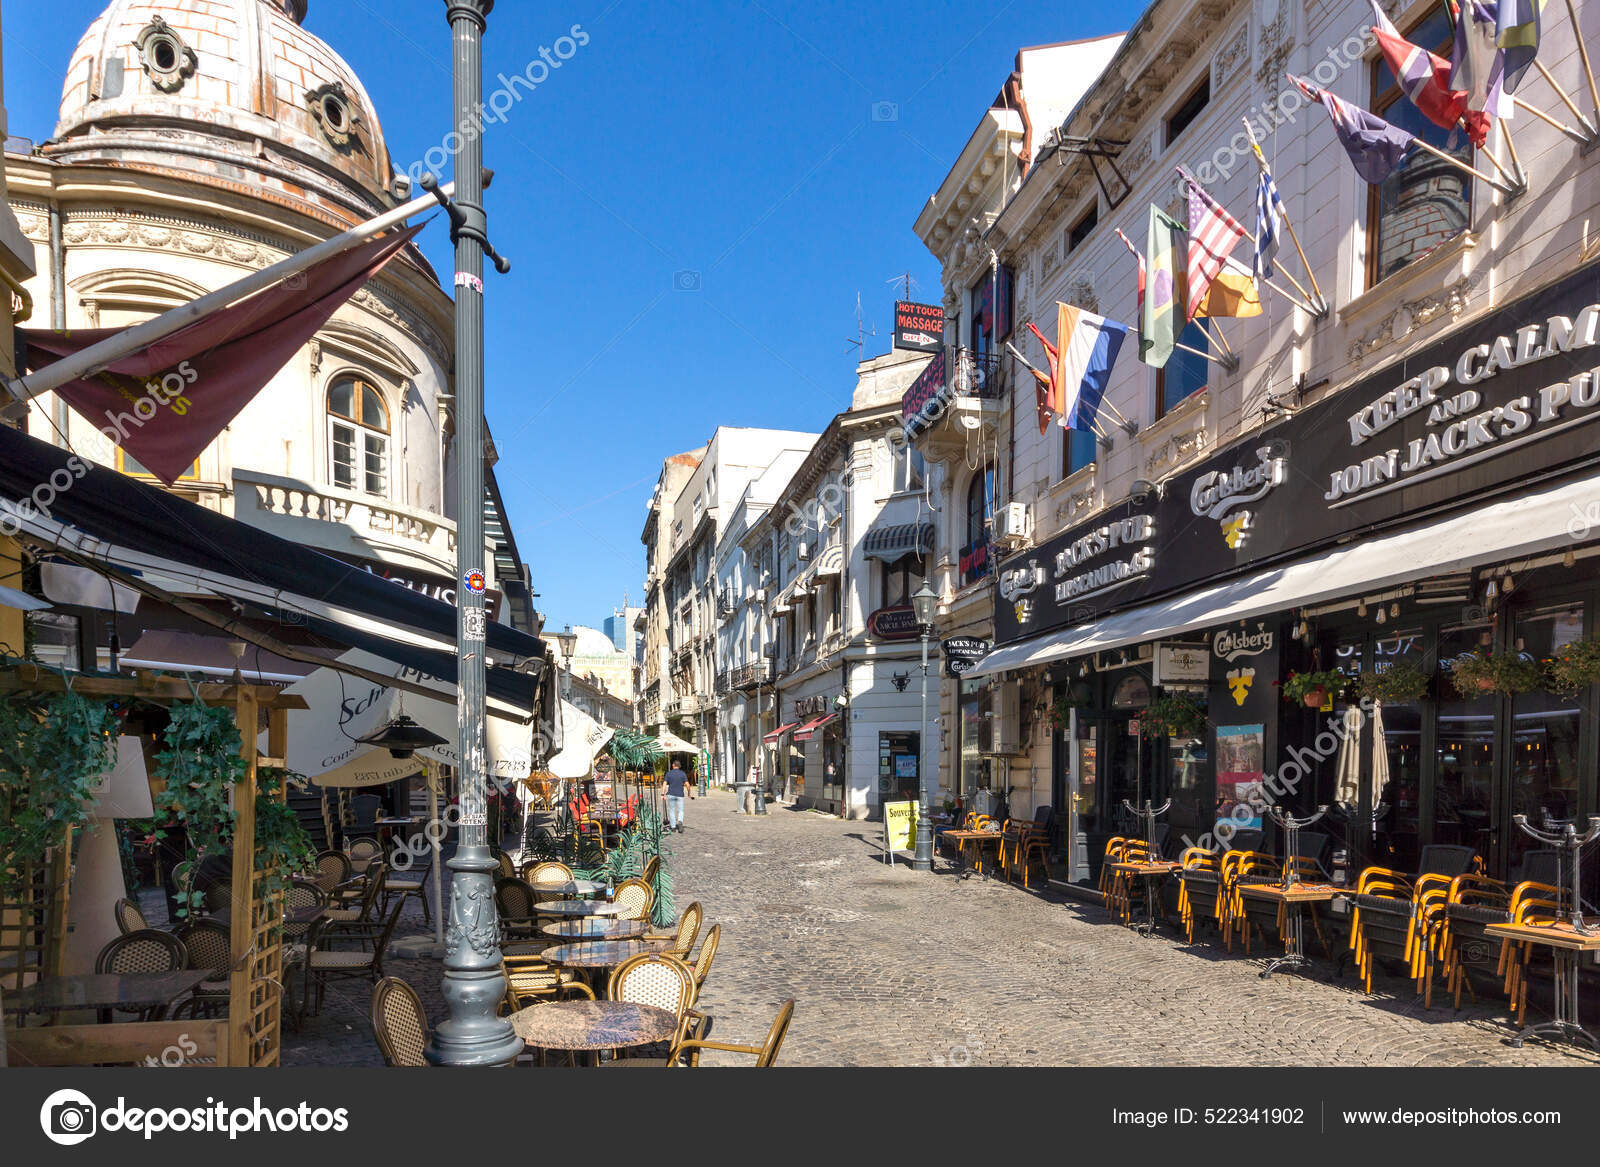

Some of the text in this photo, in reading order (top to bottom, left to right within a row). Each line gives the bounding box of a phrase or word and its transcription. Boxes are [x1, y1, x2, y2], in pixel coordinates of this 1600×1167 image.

[898, 315, 943, 333] MASSAGE
[899, 303, 943, 318] HOT TOUCH
[903, 334, 930, 343] OPEN
[1347, 303, 1600, 446] KEEP CALM
[1425, 390, 1481, 426] AND
[1324, 449, 1399, 500] JOIN
[1401, 396, 1532, 472] JACK'S
[1190, 450, 1287, 519] Carlsberg
[1054, 514, 1154, 578] JACK'S PUB
[947, 640, 985, 649] JACK'S PUB
[1213, 626, 1274, 663] Carlsberg
[494, 759, 526, 771] 1783
